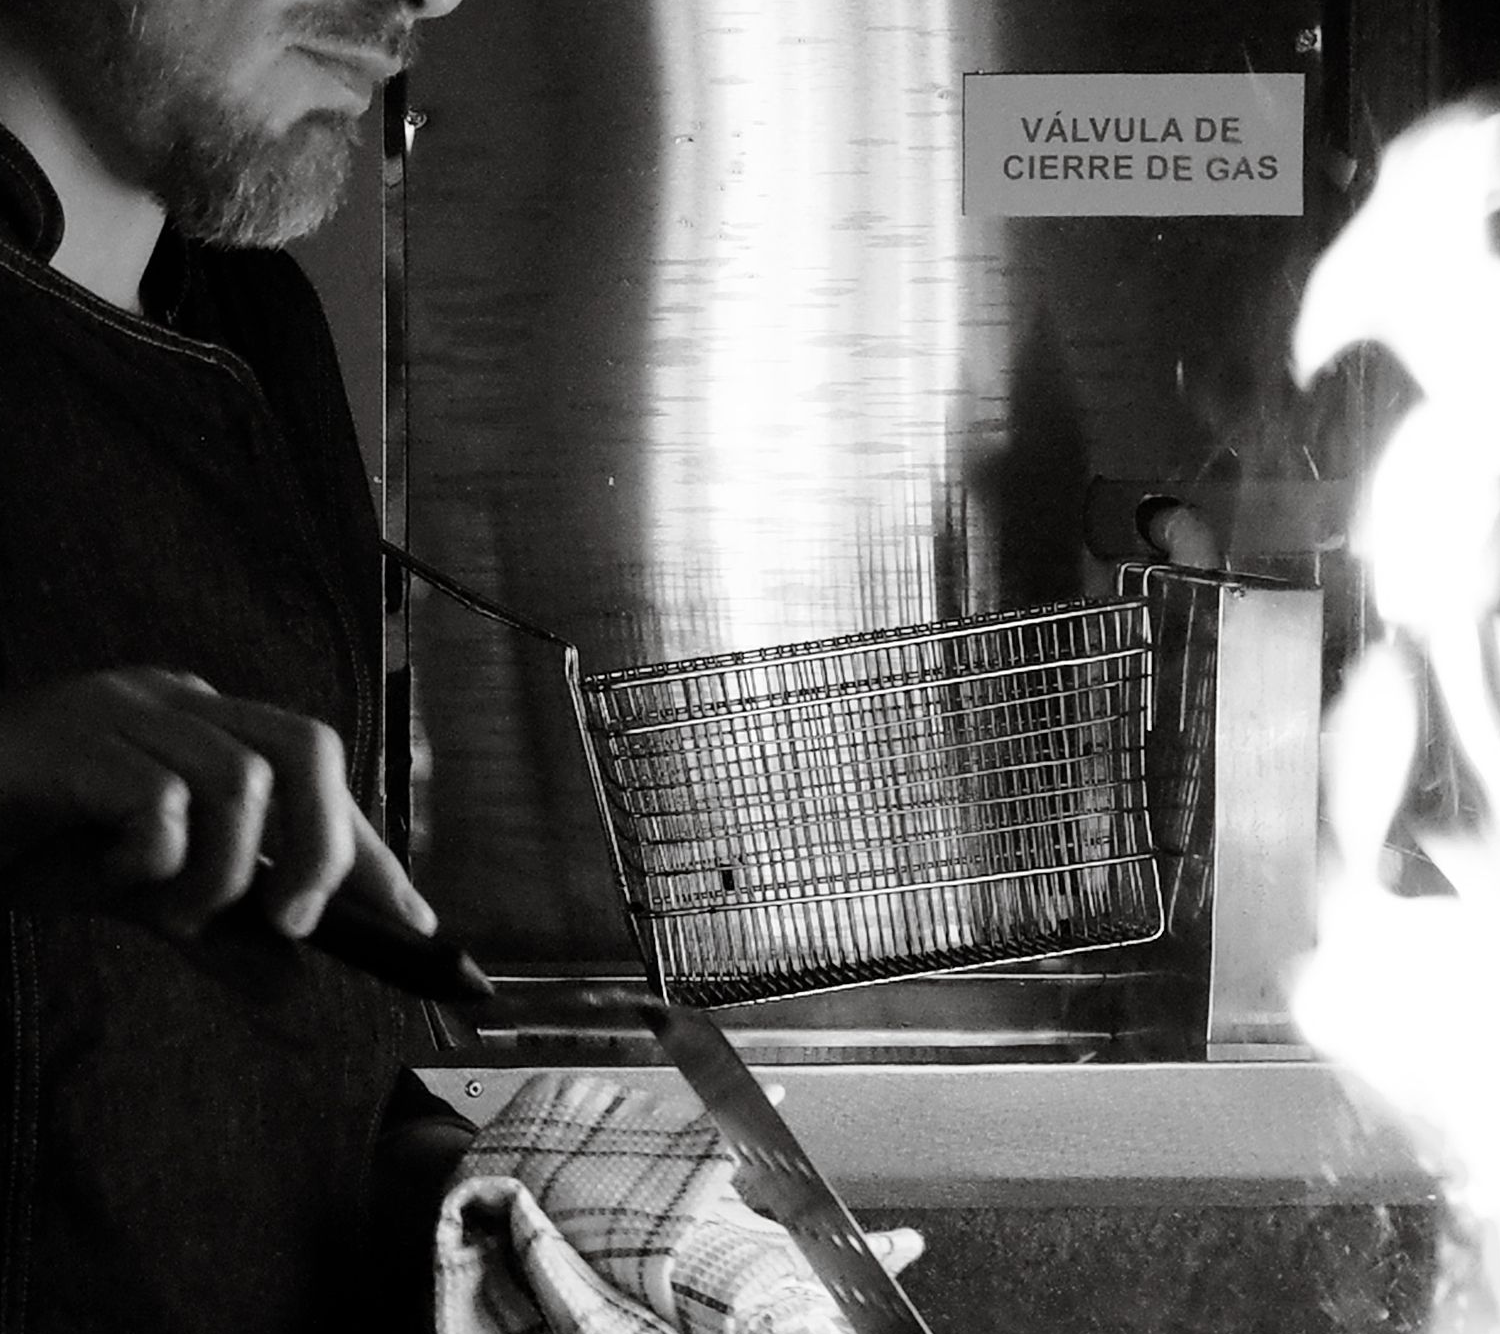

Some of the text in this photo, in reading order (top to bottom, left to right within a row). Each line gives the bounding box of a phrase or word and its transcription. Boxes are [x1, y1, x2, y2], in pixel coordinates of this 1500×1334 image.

[1021, 111, 1243, 144] VÁLVULA DE
[1003, 154, 1279, 181] CIERRE DE GAS
